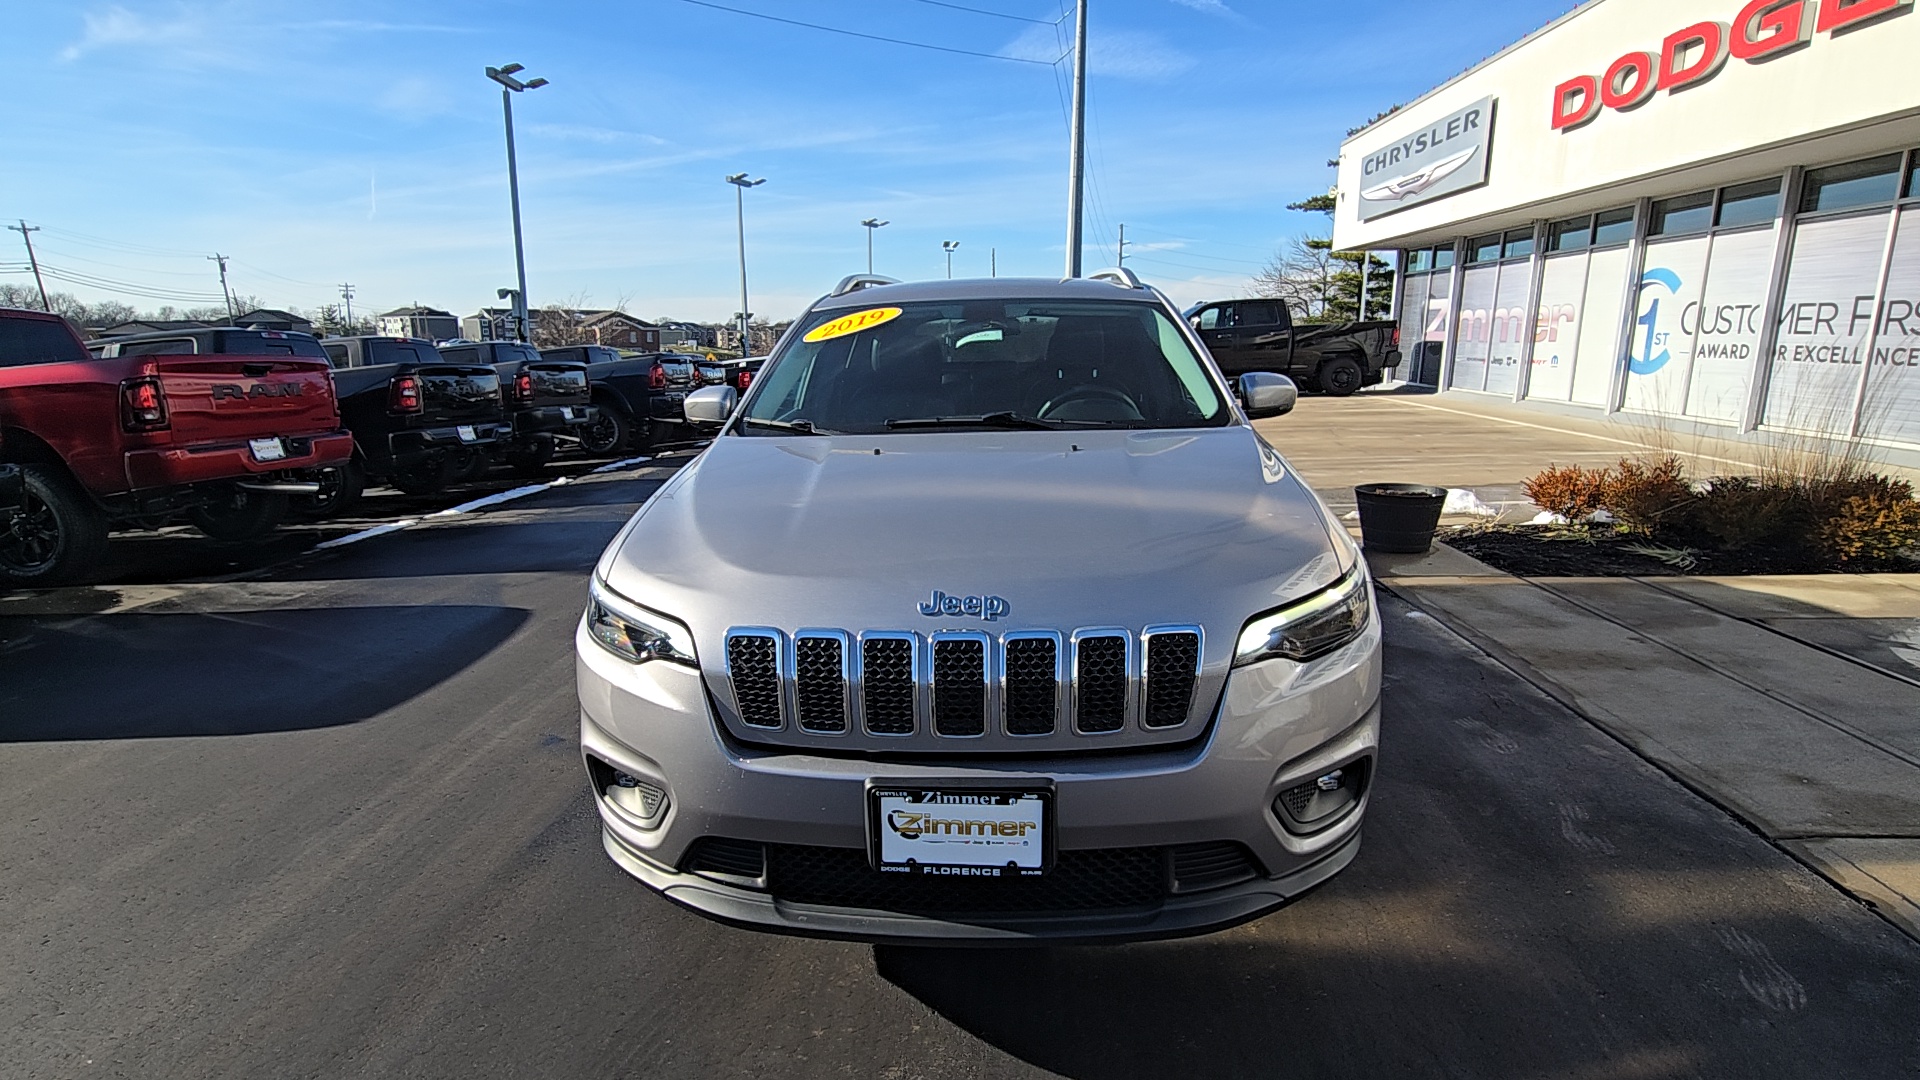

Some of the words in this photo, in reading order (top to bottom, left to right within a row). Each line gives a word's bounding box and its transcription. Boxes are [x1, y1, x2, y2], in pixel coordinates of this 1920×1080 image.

[1364, 109, 1480, 176] CHRYSLER
[823, 310, 886, 338] 2019
[1425, 298, 1575, 343] Zmmer
[1697, 343, 1750, 360] AWARD
[1793, 344, 1920, 367] EXCELLNCE
[211, 383, 303, 400] RAM
[916, 589, 1005, 621] Jeep
[921, 791, 1001, 805] Zimmer
[897, 812, 1037, 837] Zimmer
[923, 866, 1001, 876] FLORENCE
